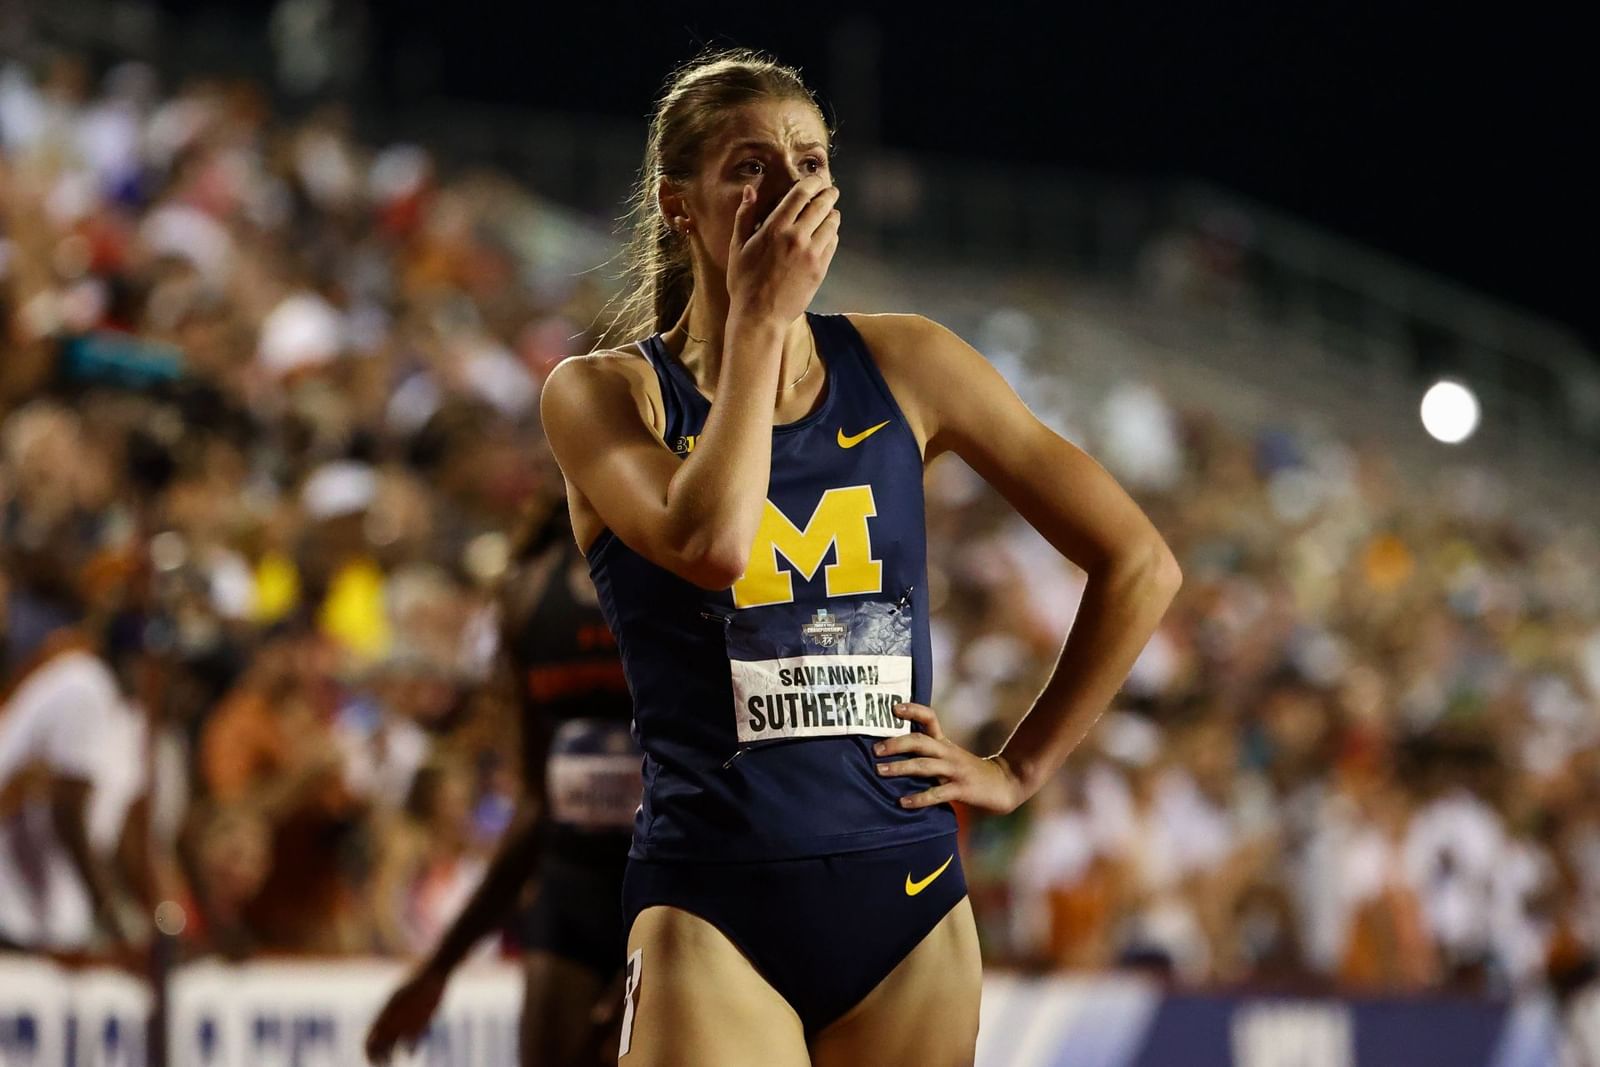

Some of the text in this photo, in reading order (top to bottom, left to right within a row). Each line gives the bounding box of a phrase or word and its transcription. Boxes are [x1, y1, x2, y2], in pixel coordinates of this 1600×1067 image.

[731, 484, 882, 609] M
[778, 665, 879, 687] SAVANNAH
[748, 692, 905, 732] SUTHERLAND
